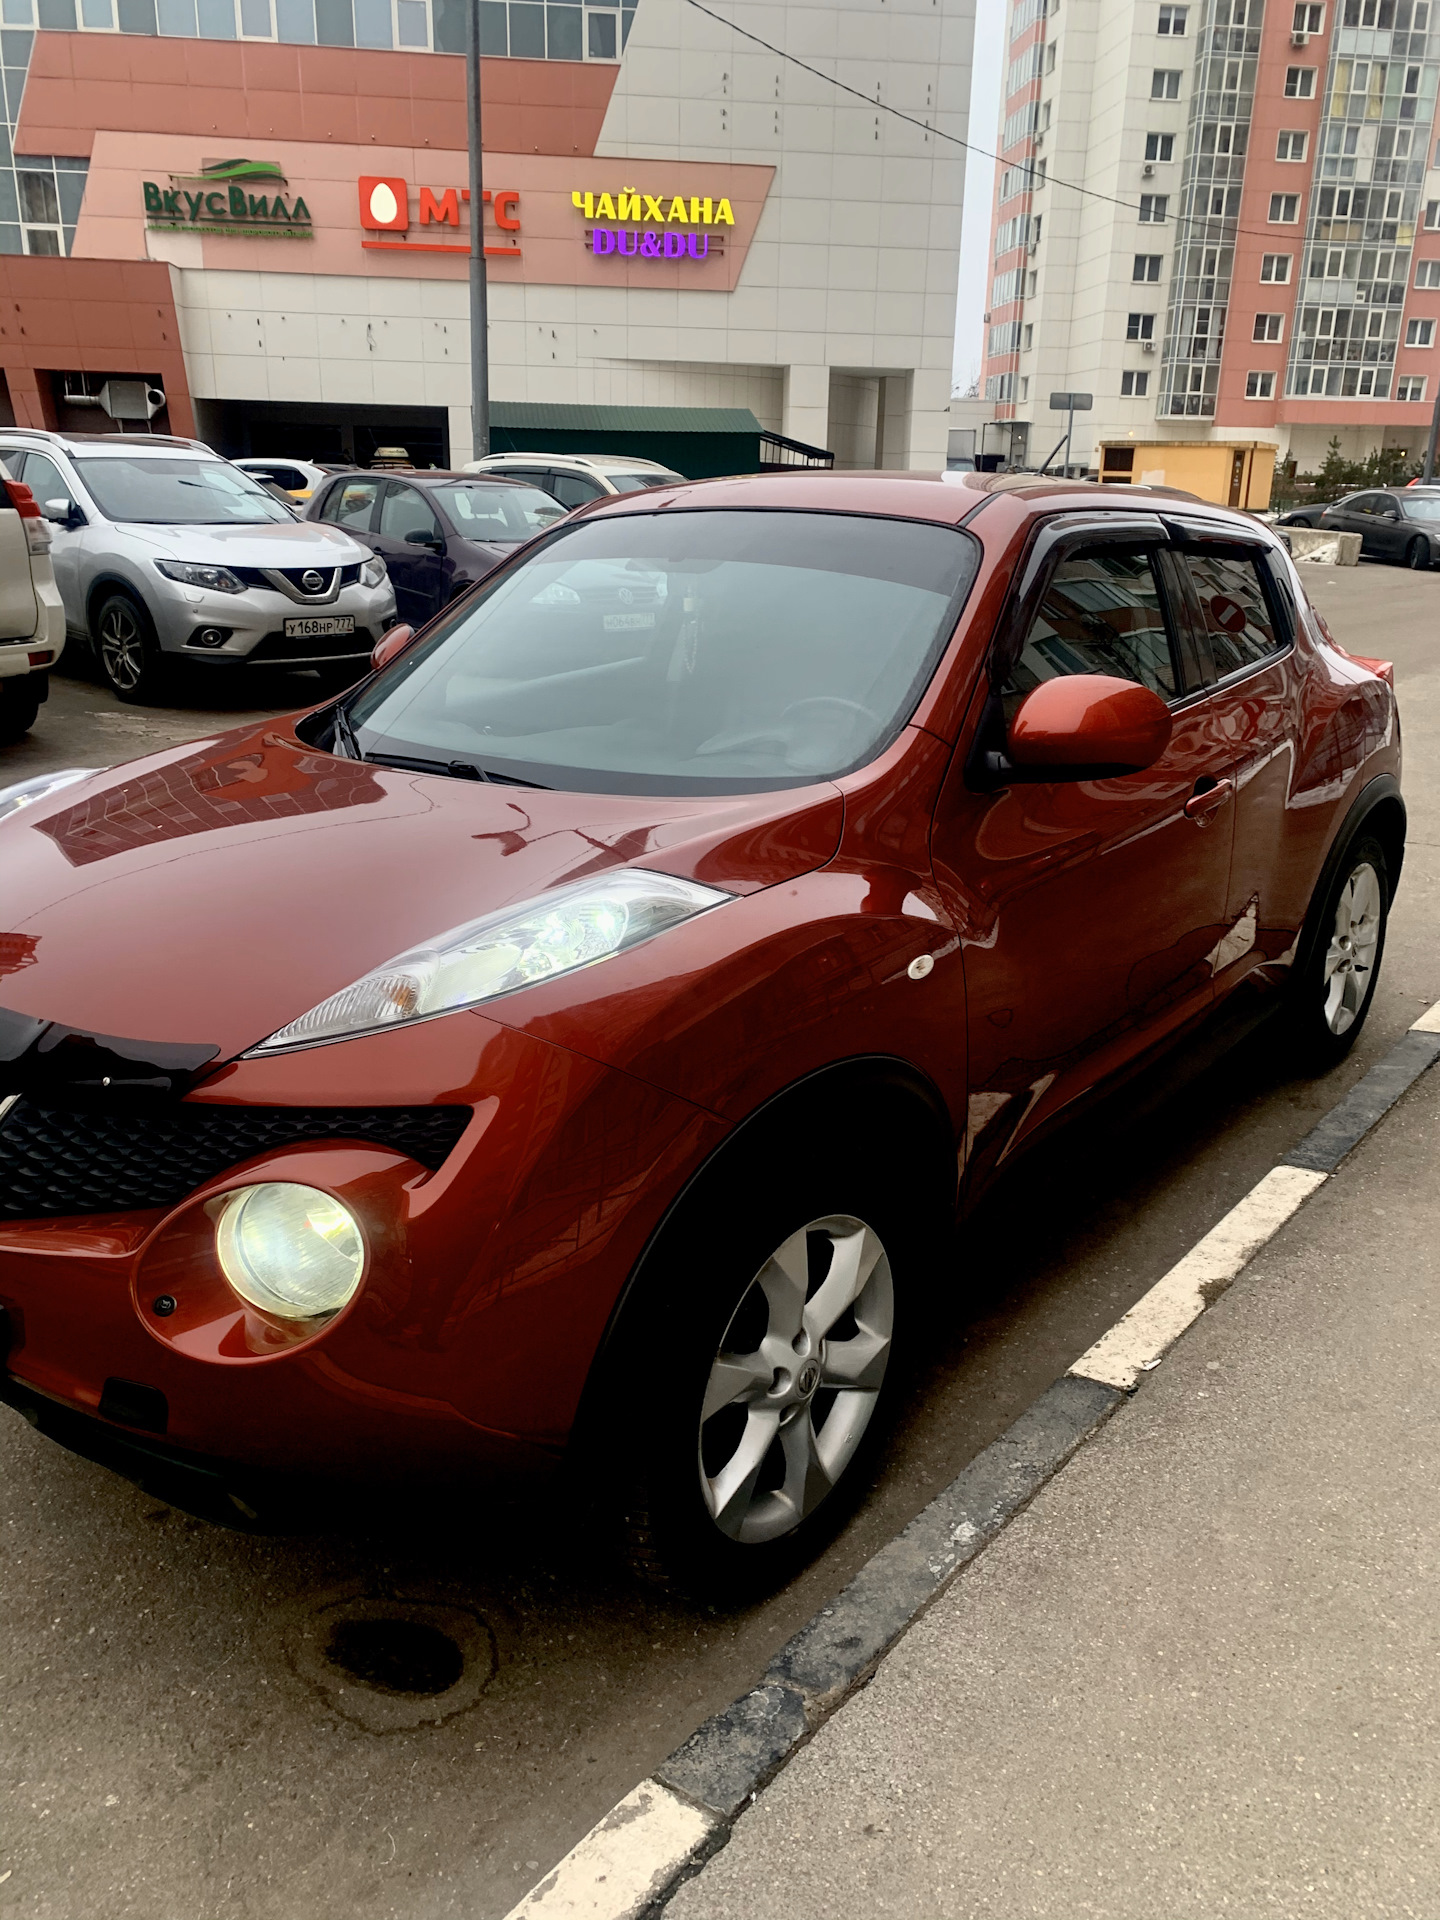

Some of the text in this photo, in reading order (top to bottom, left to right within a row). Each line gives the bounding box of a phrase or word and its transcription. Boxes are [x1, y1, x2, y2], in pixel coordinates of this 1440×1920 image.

[143, 181, 311, 221] ВкусВилл
[571, 186, 735, 225] ЧАЙХАНА
[593, 228, 709, 259] DU&DU
